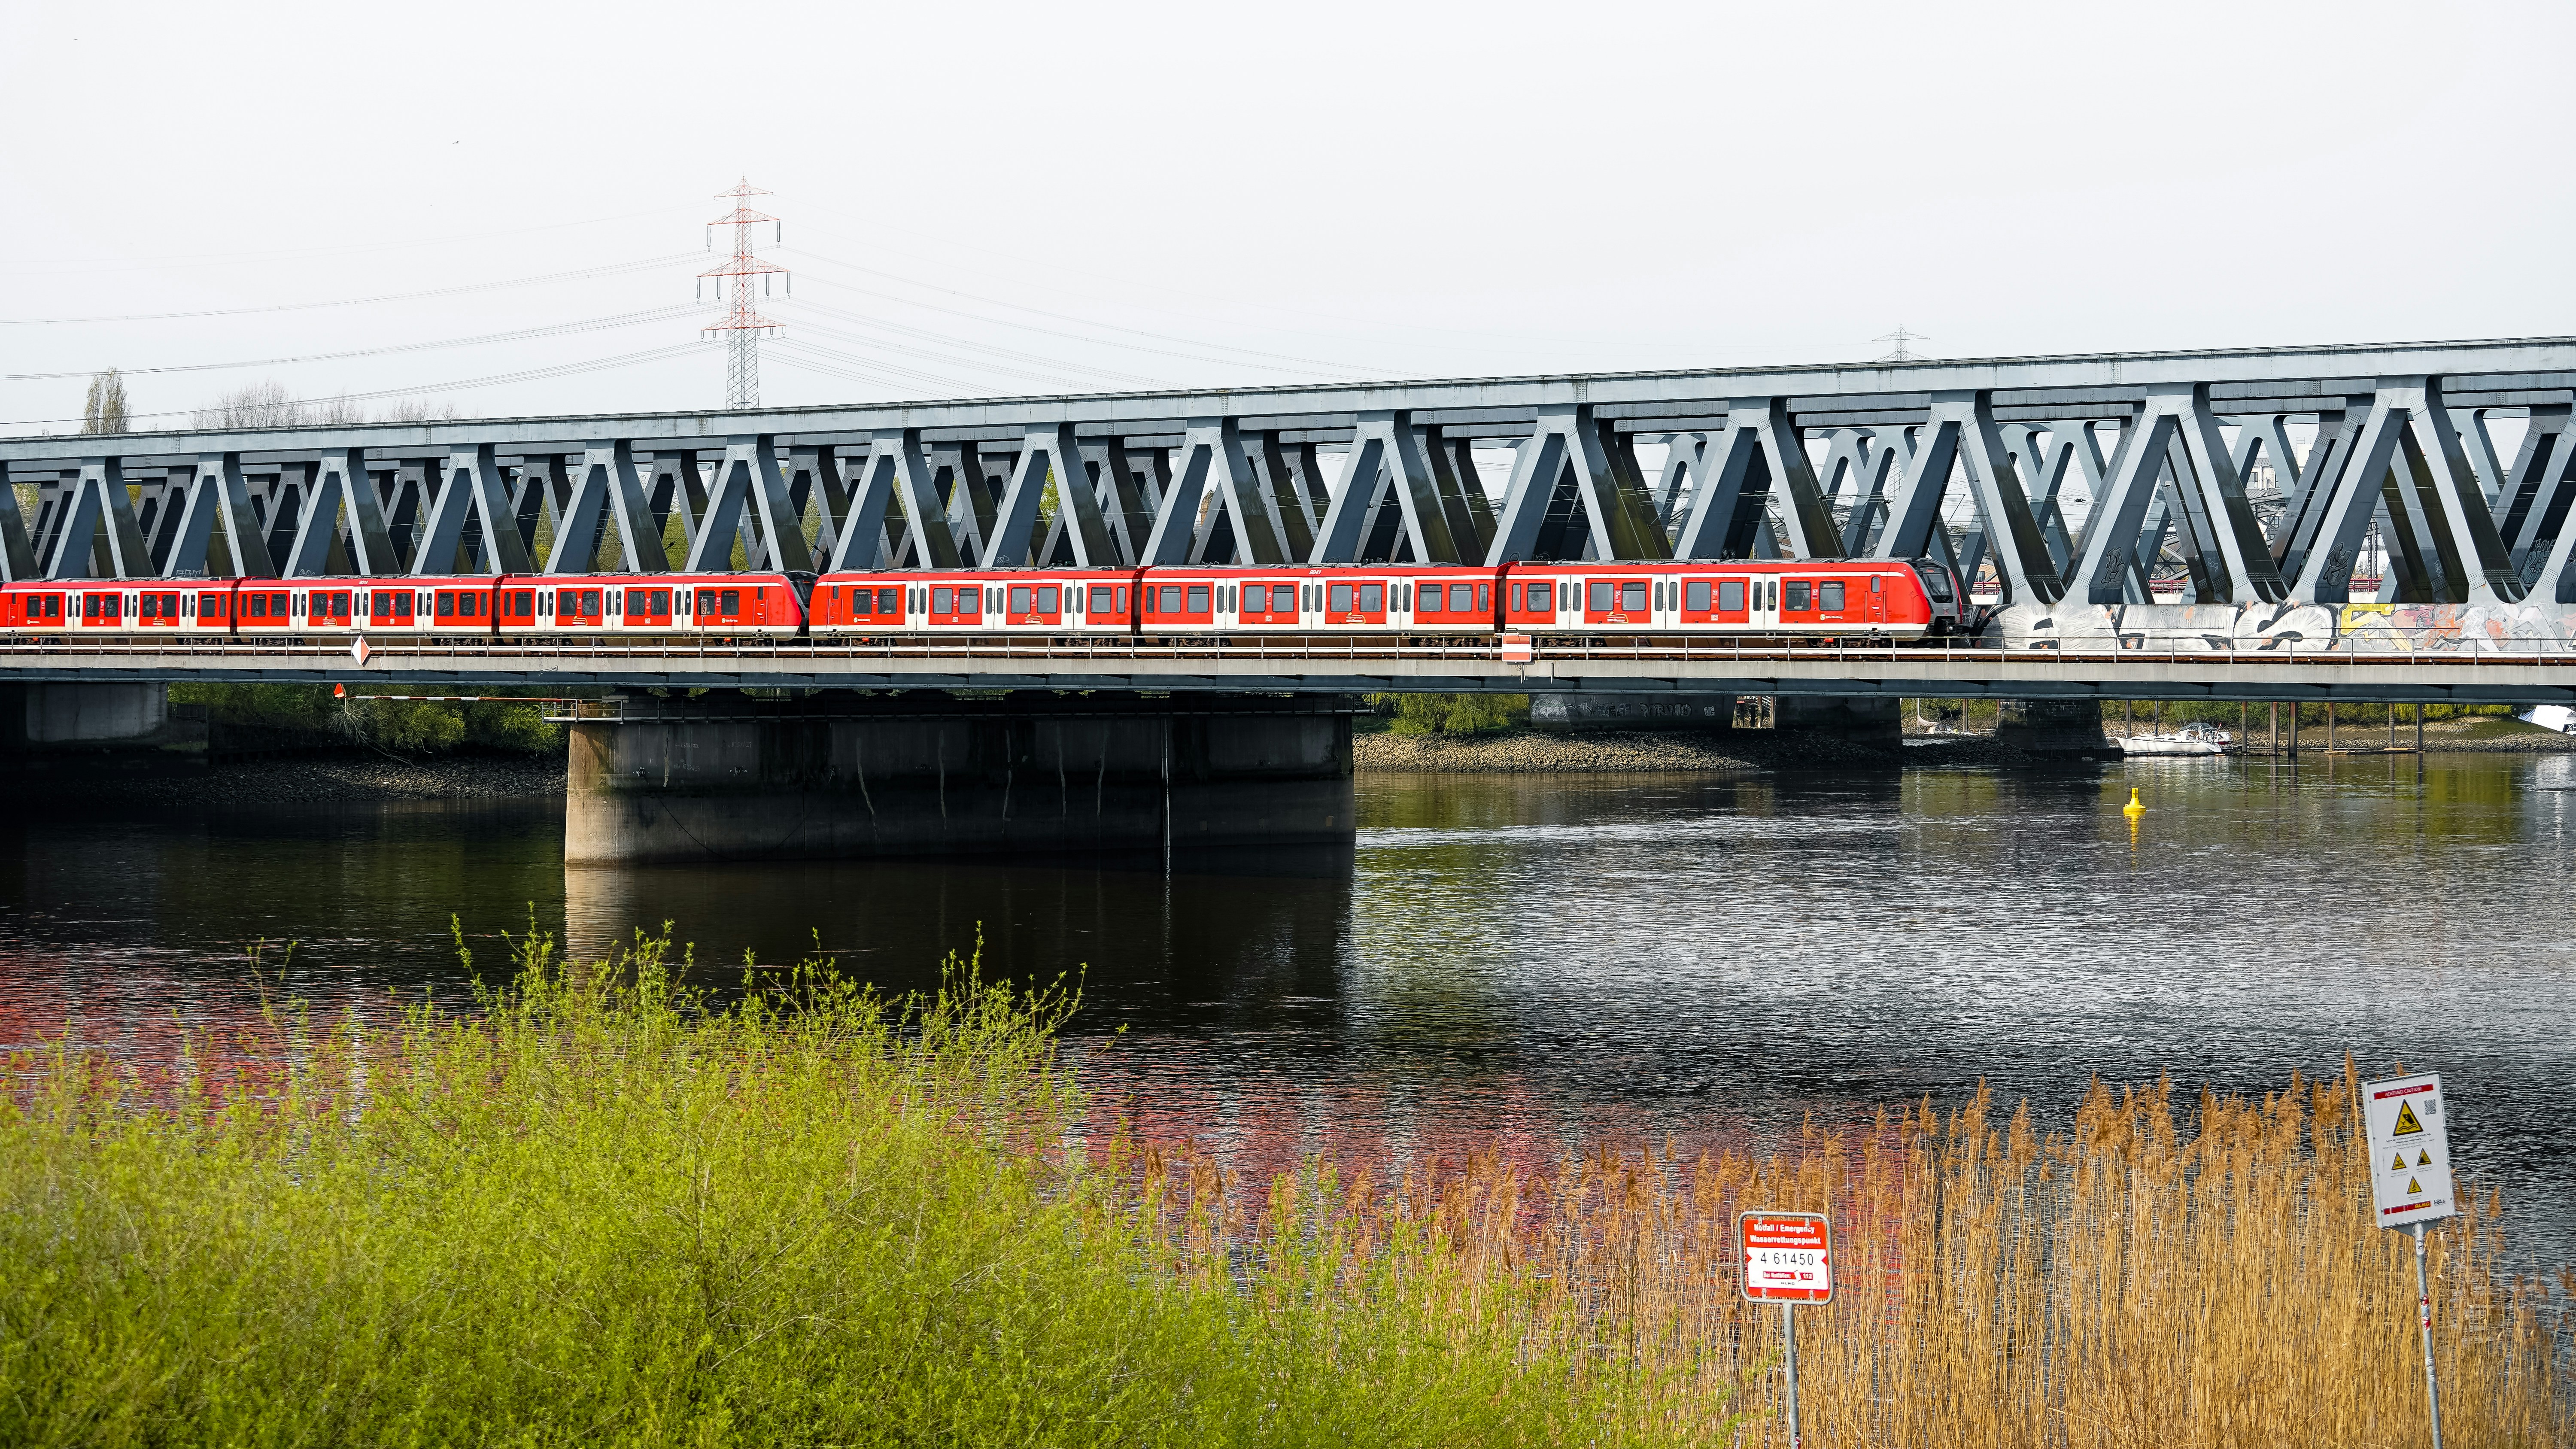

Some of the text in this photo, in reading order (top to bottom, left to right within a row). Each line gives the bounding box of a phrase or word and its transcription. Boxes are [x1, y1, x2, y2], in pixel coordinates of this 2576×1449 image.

[1754, 1224, 1775, 1232] Notfall
[1780, 1224, 1815, 1234] Emergency
[1750, 1235, 1821, 1245] Wasserrettungspunkt
[1761, 1252, 1767, 1264] 4
